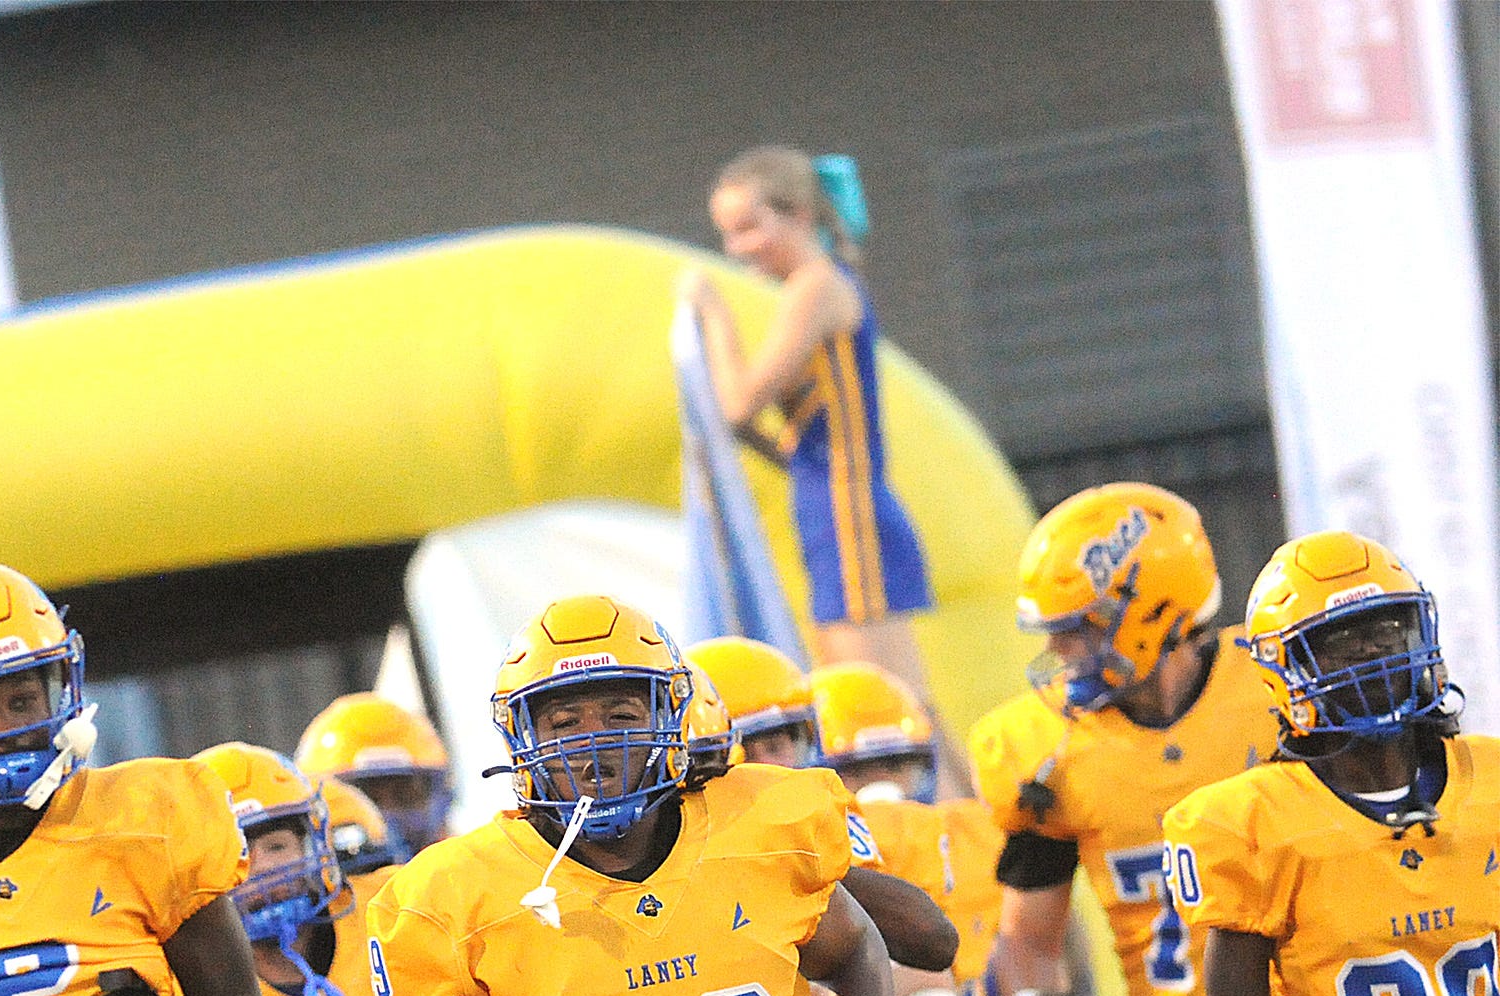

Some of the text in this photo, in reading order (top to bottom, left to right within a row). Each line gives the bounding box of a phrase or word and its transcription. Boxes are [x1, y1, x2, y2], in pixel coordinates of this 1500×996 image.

[560, 656, 610, 670] Riddell
[1391, 907, 1455, 936] LANEY
[625, 954, 697, 990] LANEY
